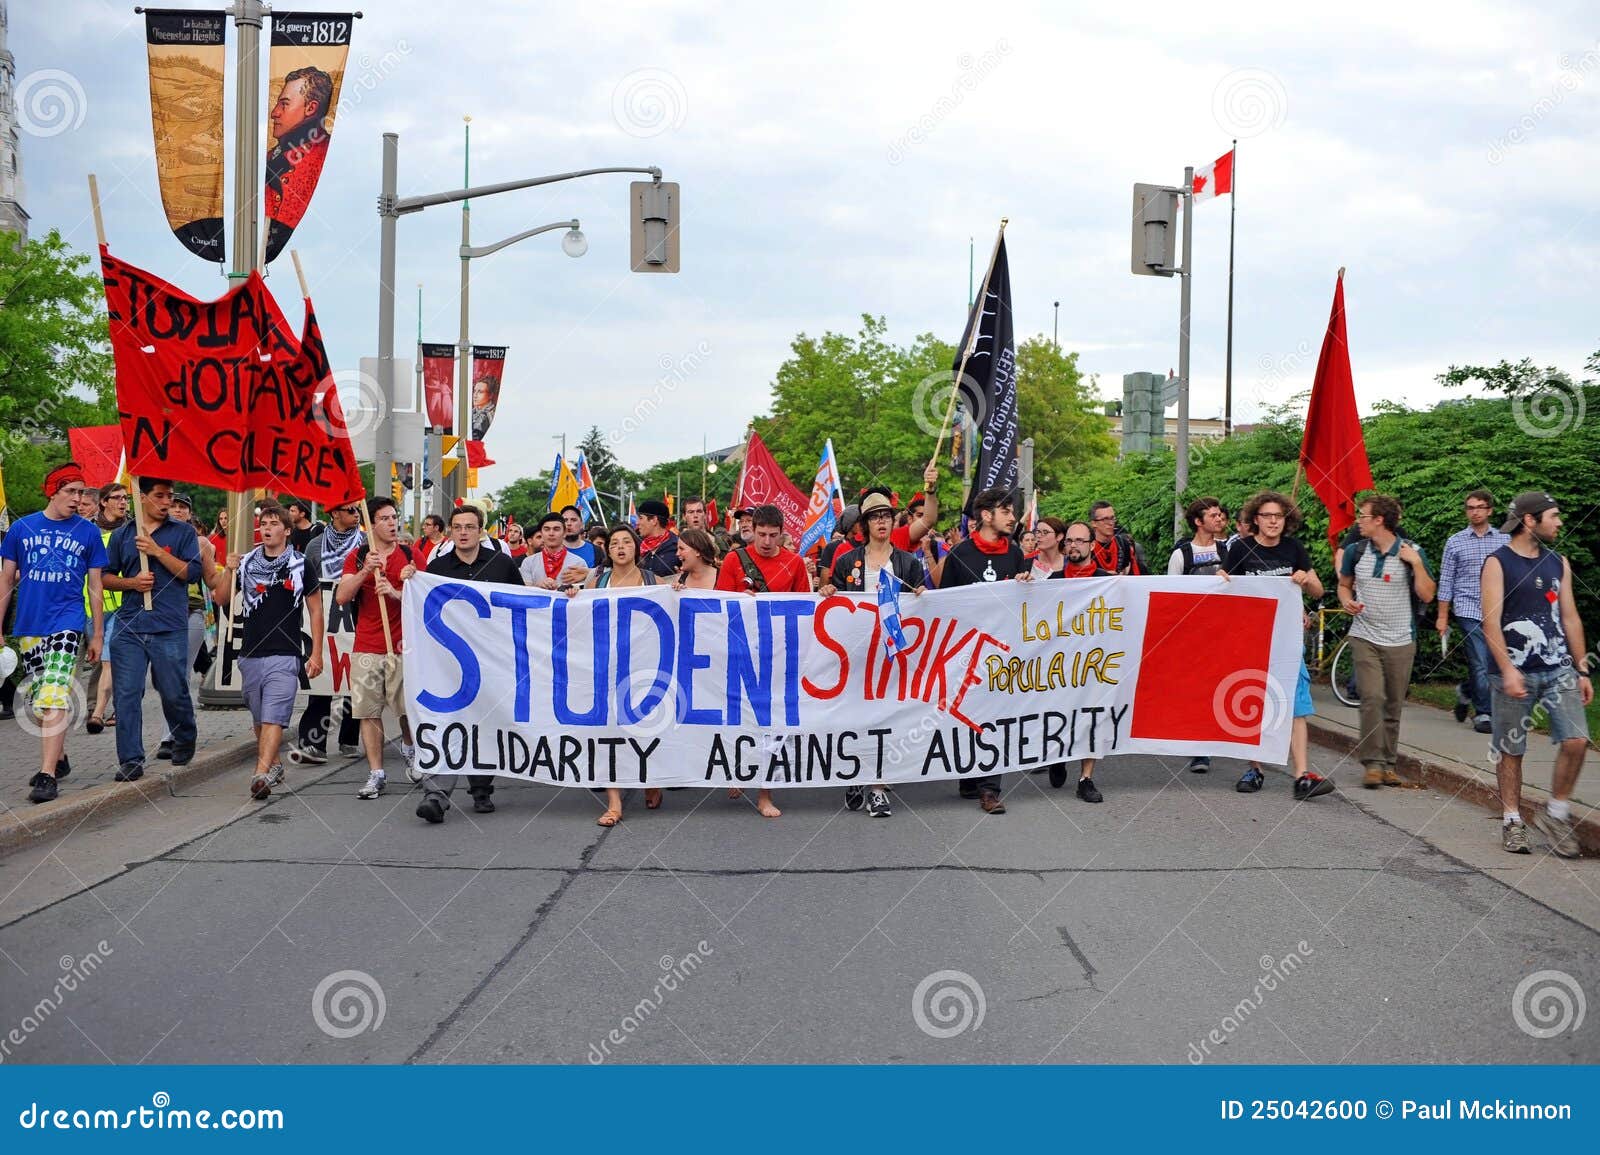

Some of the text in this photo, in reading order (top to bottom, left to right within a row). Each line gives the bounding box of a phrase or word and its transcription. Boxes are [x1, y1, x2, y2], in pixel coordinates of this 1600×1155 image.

[192, 28, 221, 43] Heights
[275, 19, 312, 33] La guerre
[301, 20, 347, 43] de 1812
[22, 535, 85, 556] PING PONG
[27, 551, 78, 568] 19 81
[28, 569, 71, 583] CHAMPS
[1022, 602, 1052, 642] La
[416, 582, 816, 726] STUDENT
[800, 595, 1011, 734] STRIKE
[984, 647, 1126, 694] POPULAIRE
[415, 704, 1129, 784] SOLIDARITY AGAINST AUSTERITY
